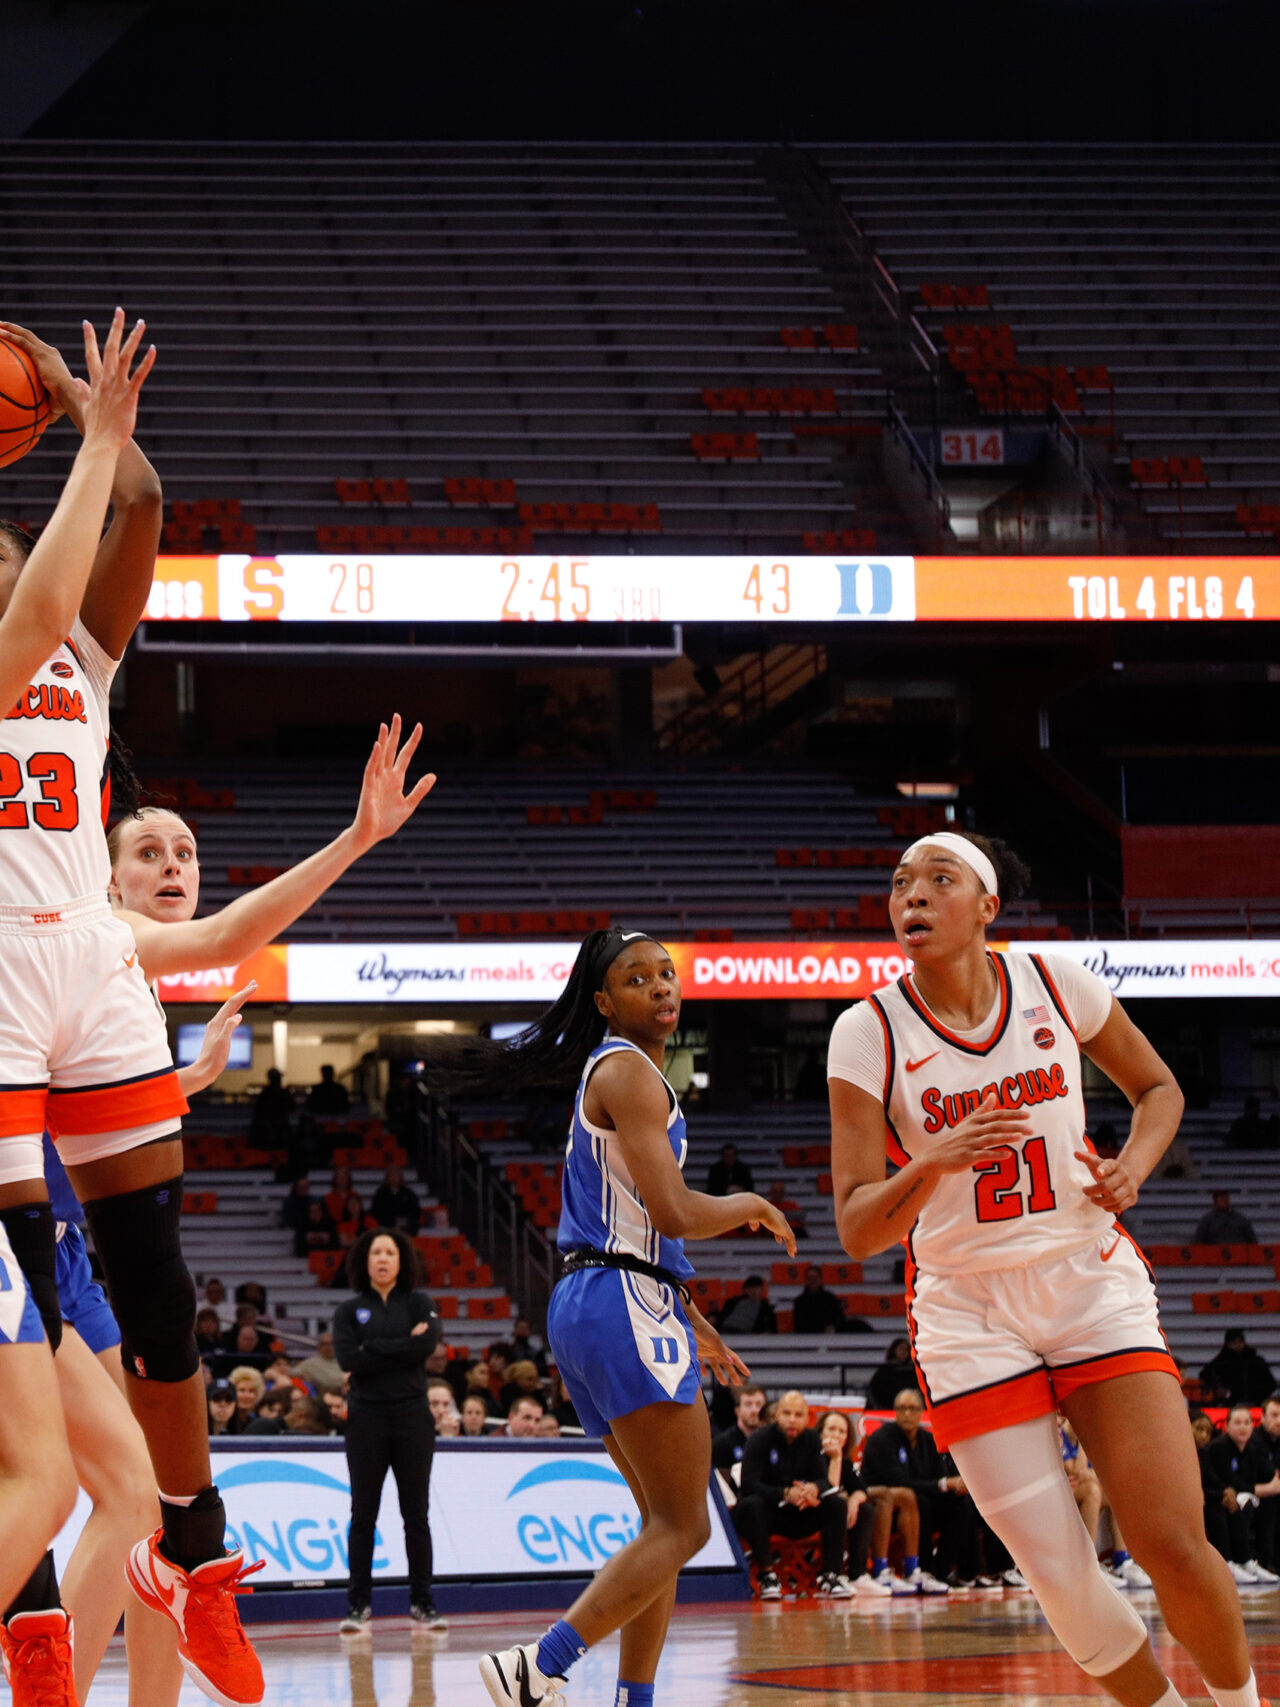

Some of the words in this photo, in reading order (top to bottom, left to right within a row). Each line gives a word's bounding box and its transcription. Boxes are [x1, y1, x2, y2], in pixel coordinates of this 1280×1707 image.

[943, 434, 1002, 463] 314
[328, 562, 375, 615] 28
[500, 560, 591, 618] 2:45
[742, 562, 791, 615] 43
[1068, 575, 1125, 619] TOL
[1136, 576, 1157, 619] 4
[1235, 575, 1256, 619] 4
[358, 952, 465, 996] Wegmans
[469, 960, 536, 982] meals
[693, 956, 862, 985] DOWNLOAD
[1190, 956, 1256, 979] meals
[972, 1136, 1057, 1223] 21
